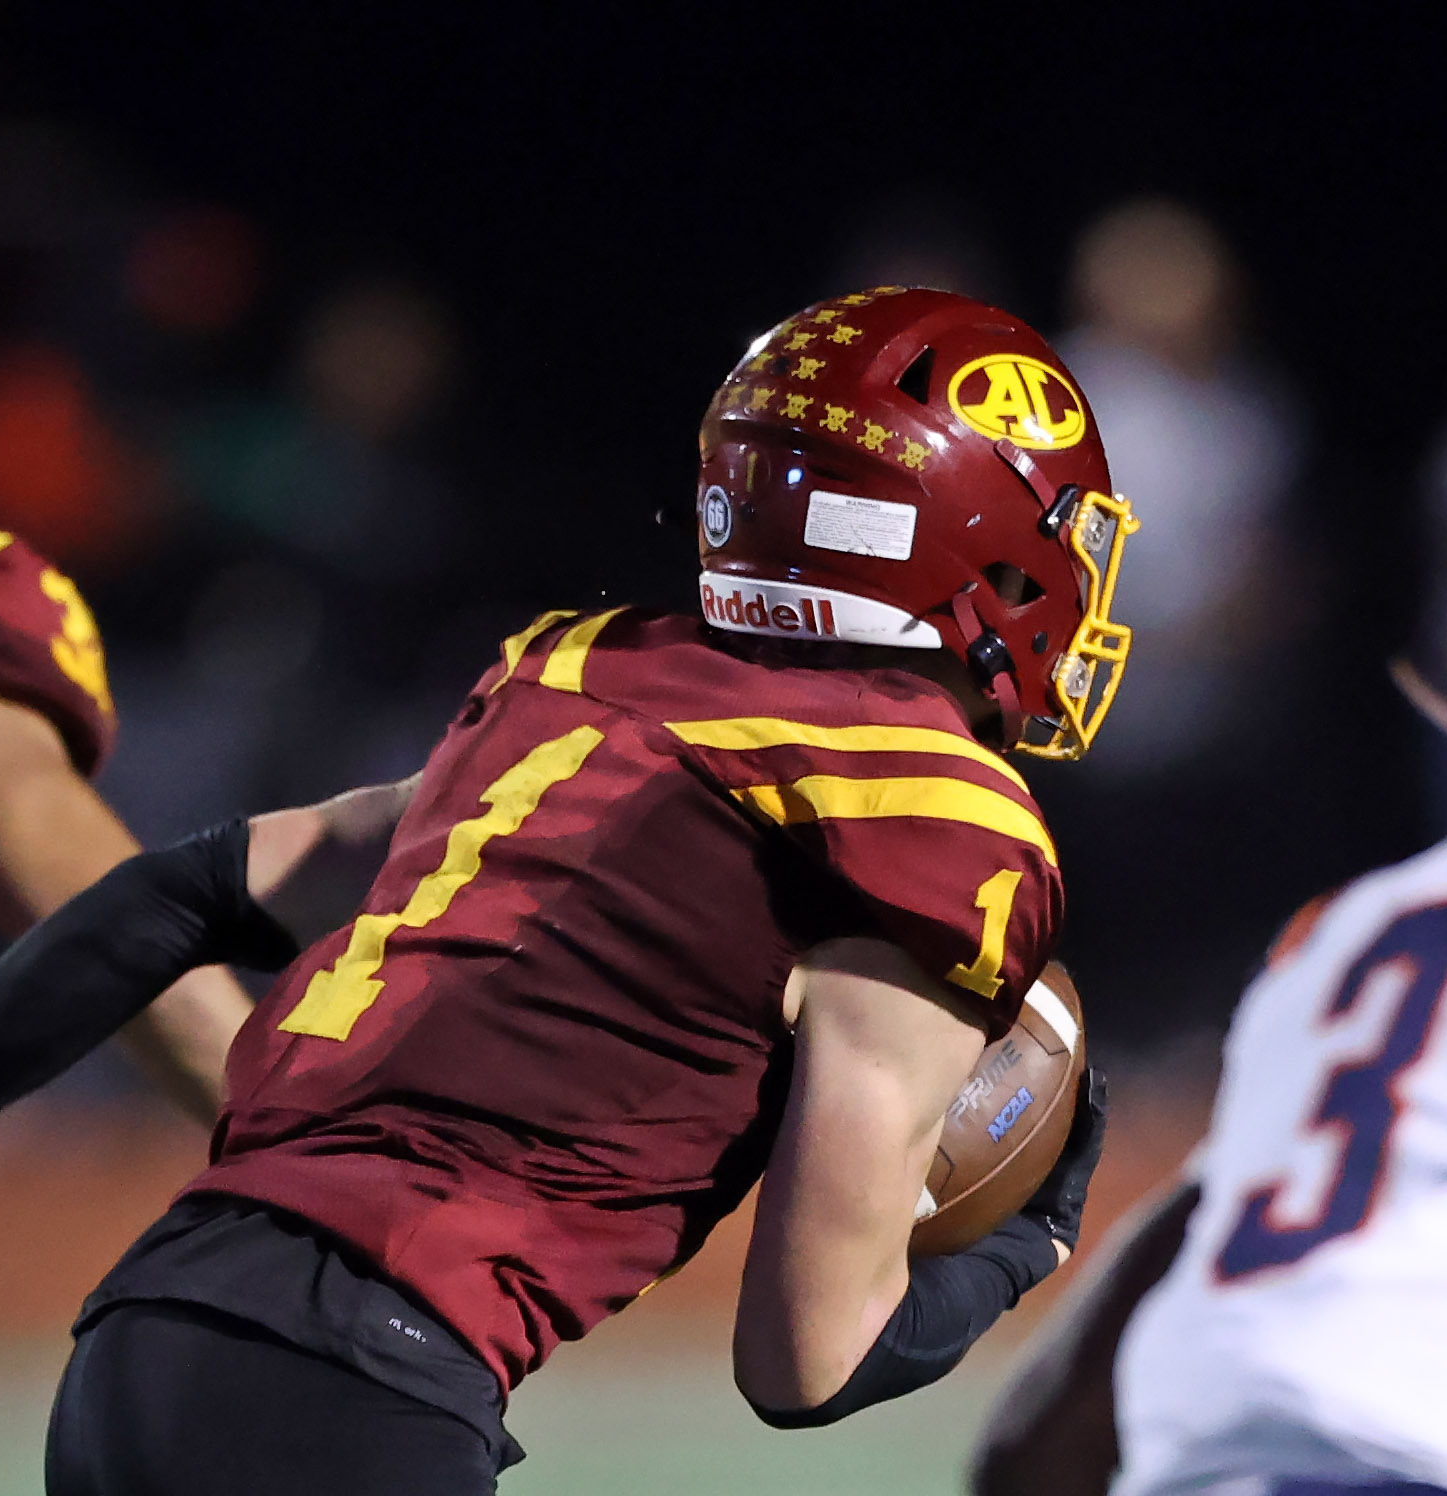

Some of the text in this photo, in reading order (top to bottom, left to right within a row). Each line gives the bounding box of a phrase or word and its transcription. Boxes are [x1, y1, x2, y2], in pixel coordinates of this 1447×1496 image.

[958, 360, 1083, 441] AL
[703, 584, 838, 637] Riddell
[277, 725, 606, 1043] 1
[948, 869, 1023, 1000] 1
[986, 1085, 1035, 1144] NCAA
